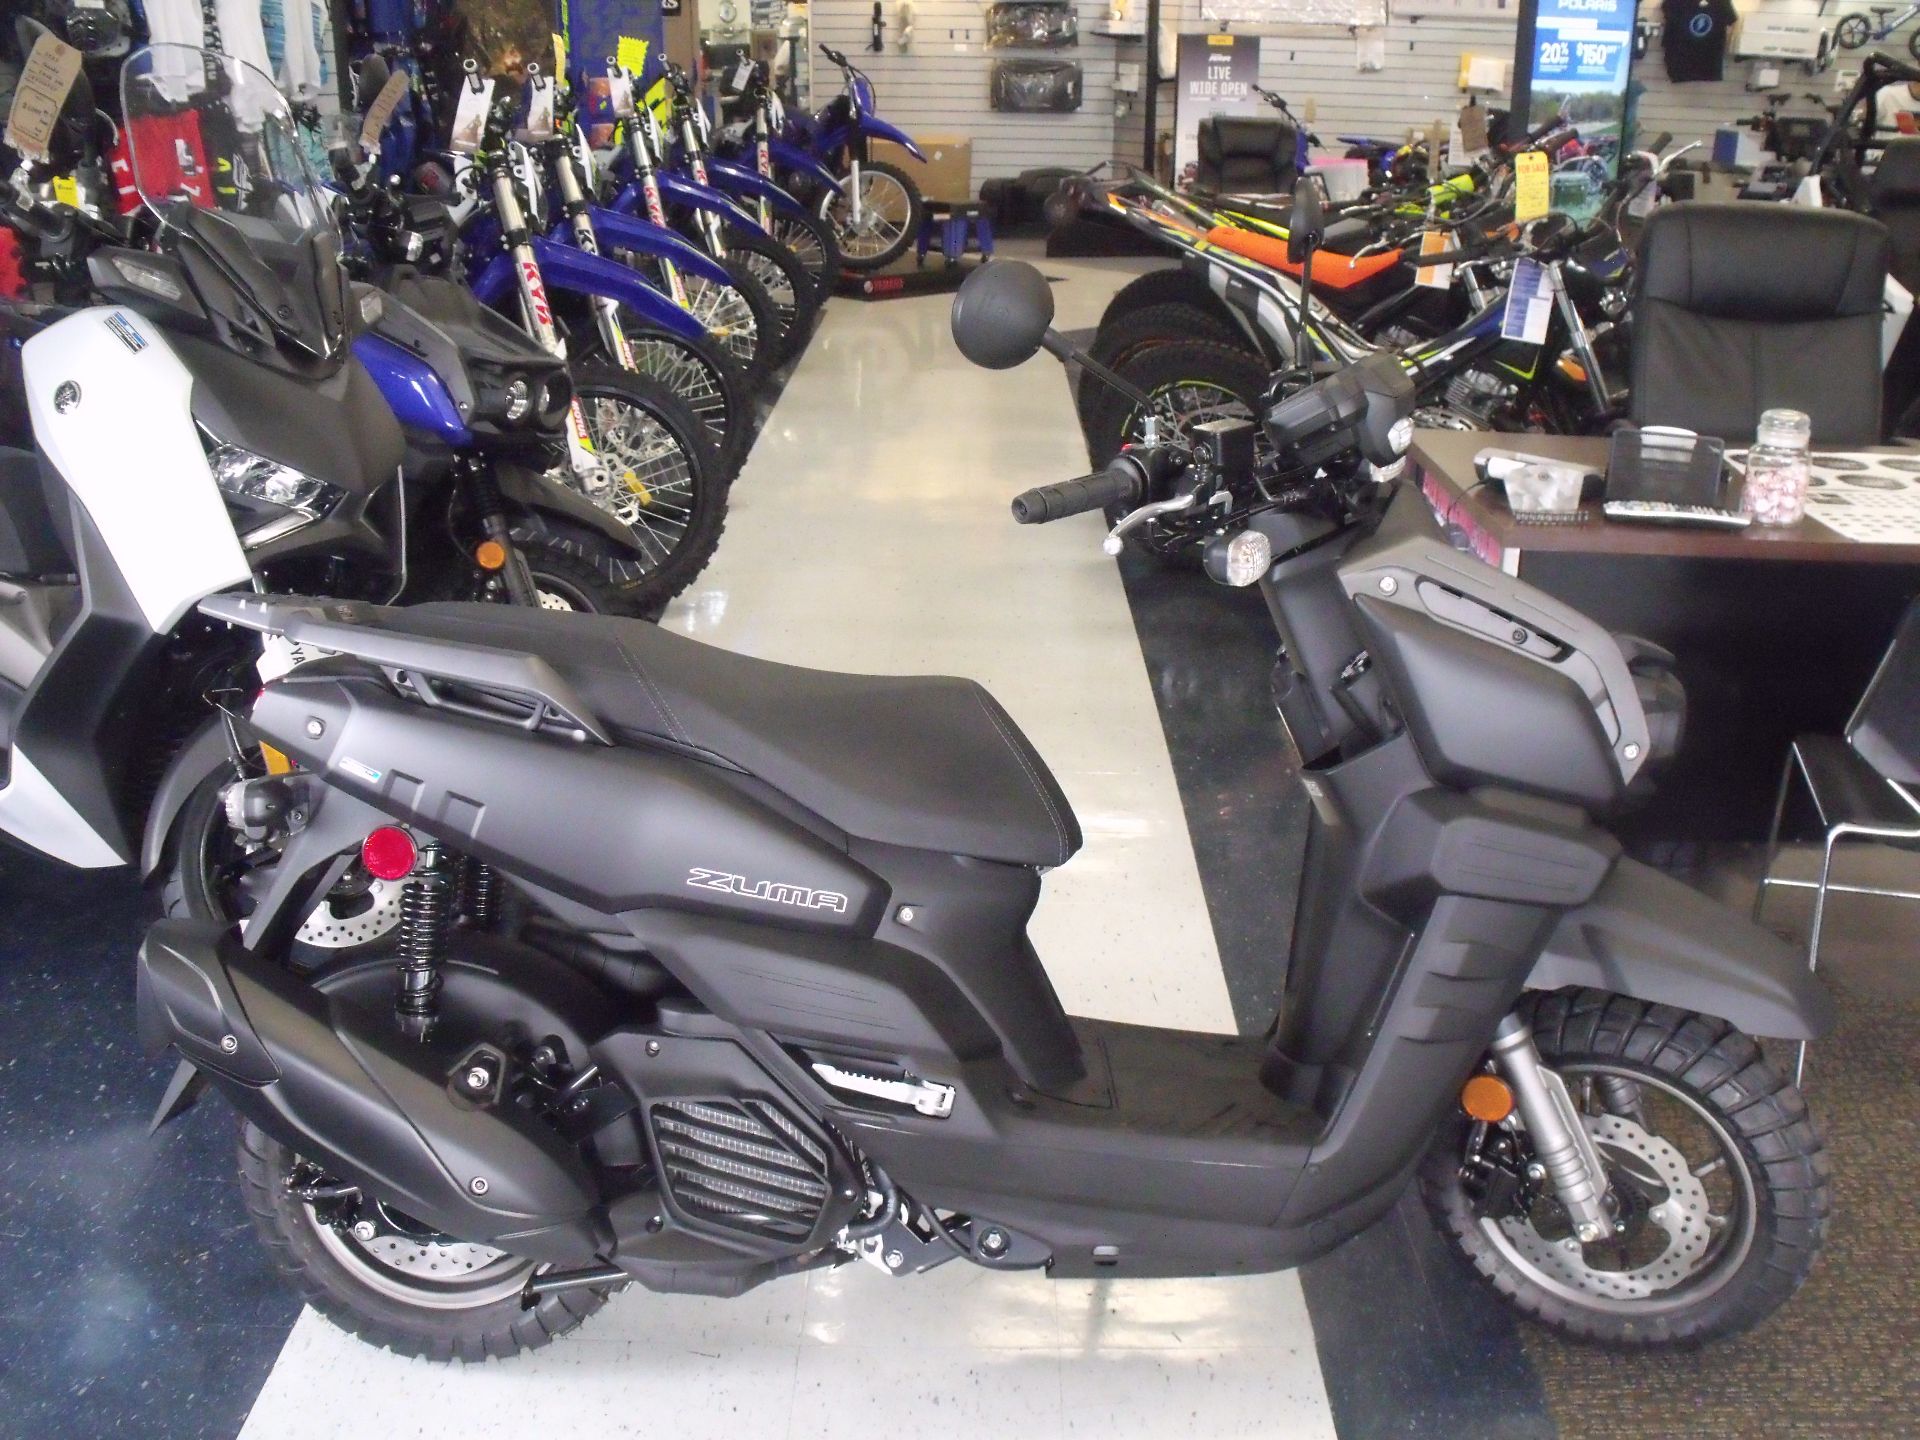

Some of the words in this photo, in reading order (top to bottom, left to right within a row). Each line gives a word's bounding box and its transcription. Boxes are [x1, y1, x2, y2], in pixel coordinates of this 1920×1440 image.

[1208, 66, 1231, 80] LIVE
[1190, 81, 1218, 95] WIDE
[1220, 81, 1248, 95] OPEN
[686, 867, 848, 913] ZUMA
